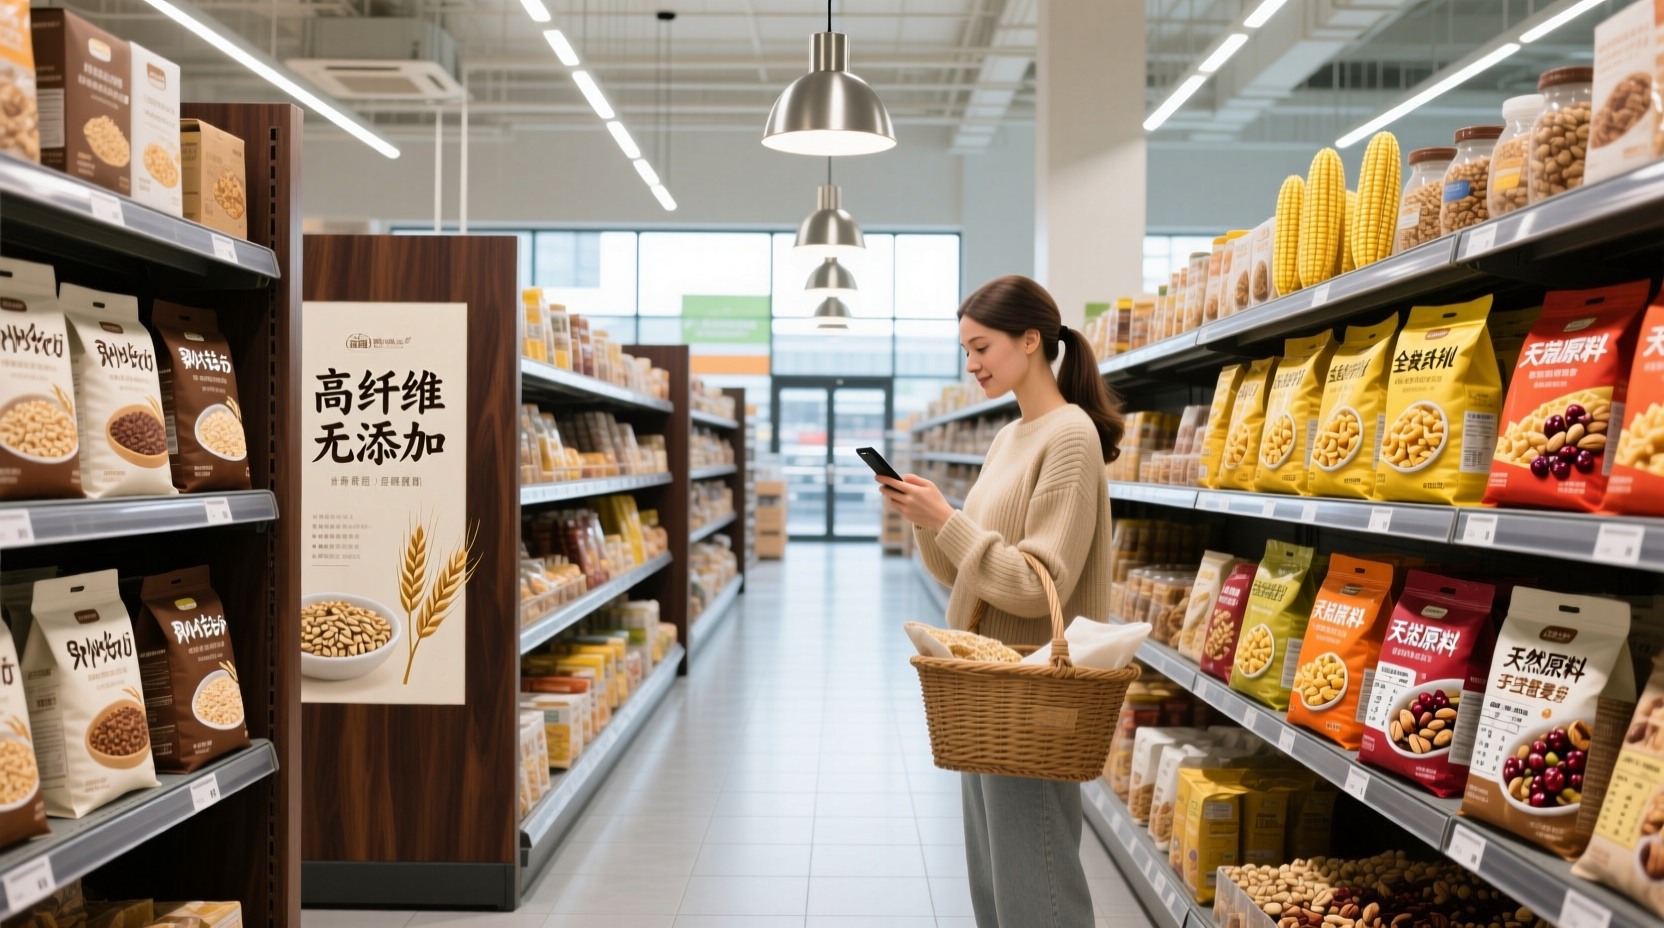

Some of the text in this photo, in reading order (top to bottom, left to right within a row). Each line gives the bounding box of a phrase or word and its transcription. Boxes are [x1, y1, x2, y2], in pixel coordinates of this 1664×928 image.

[315, 367, 446, 415] 高纤维
[312, 420, 446, 466] 无添加
[1503, 646, 1588, 684] 天然原料
